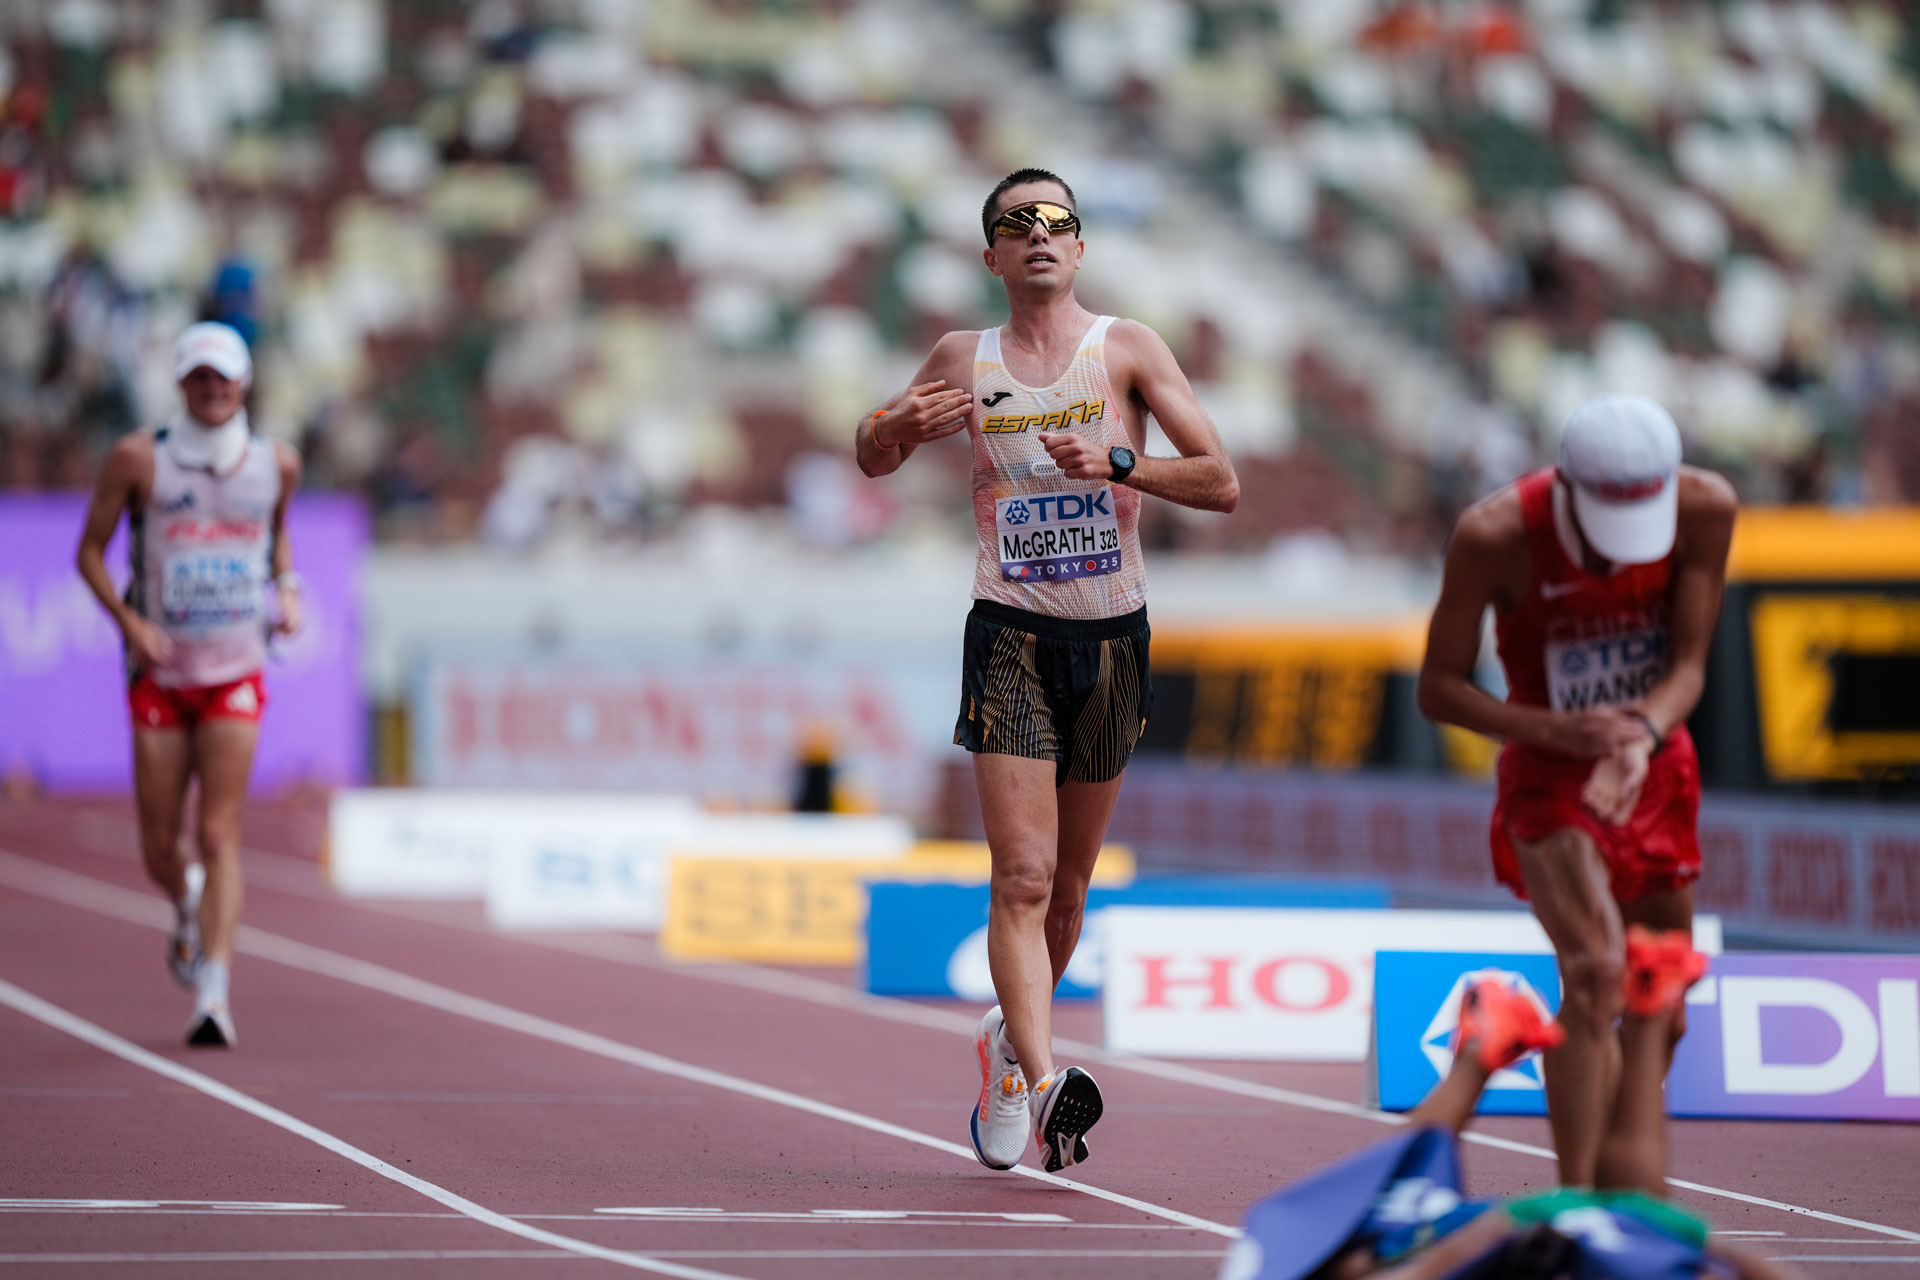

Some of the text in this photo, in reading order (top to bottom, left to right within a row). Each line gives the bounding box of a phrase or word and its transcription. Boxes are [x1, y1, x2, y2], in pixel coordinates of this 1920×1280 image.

[981, 400, 1105, 433] ESPAÑA
[1028, 490, 1110, 522] TDK
[1003, 526, 1119, 560] McGRATH 328
[1134, 952, 1374, 1016] HO
